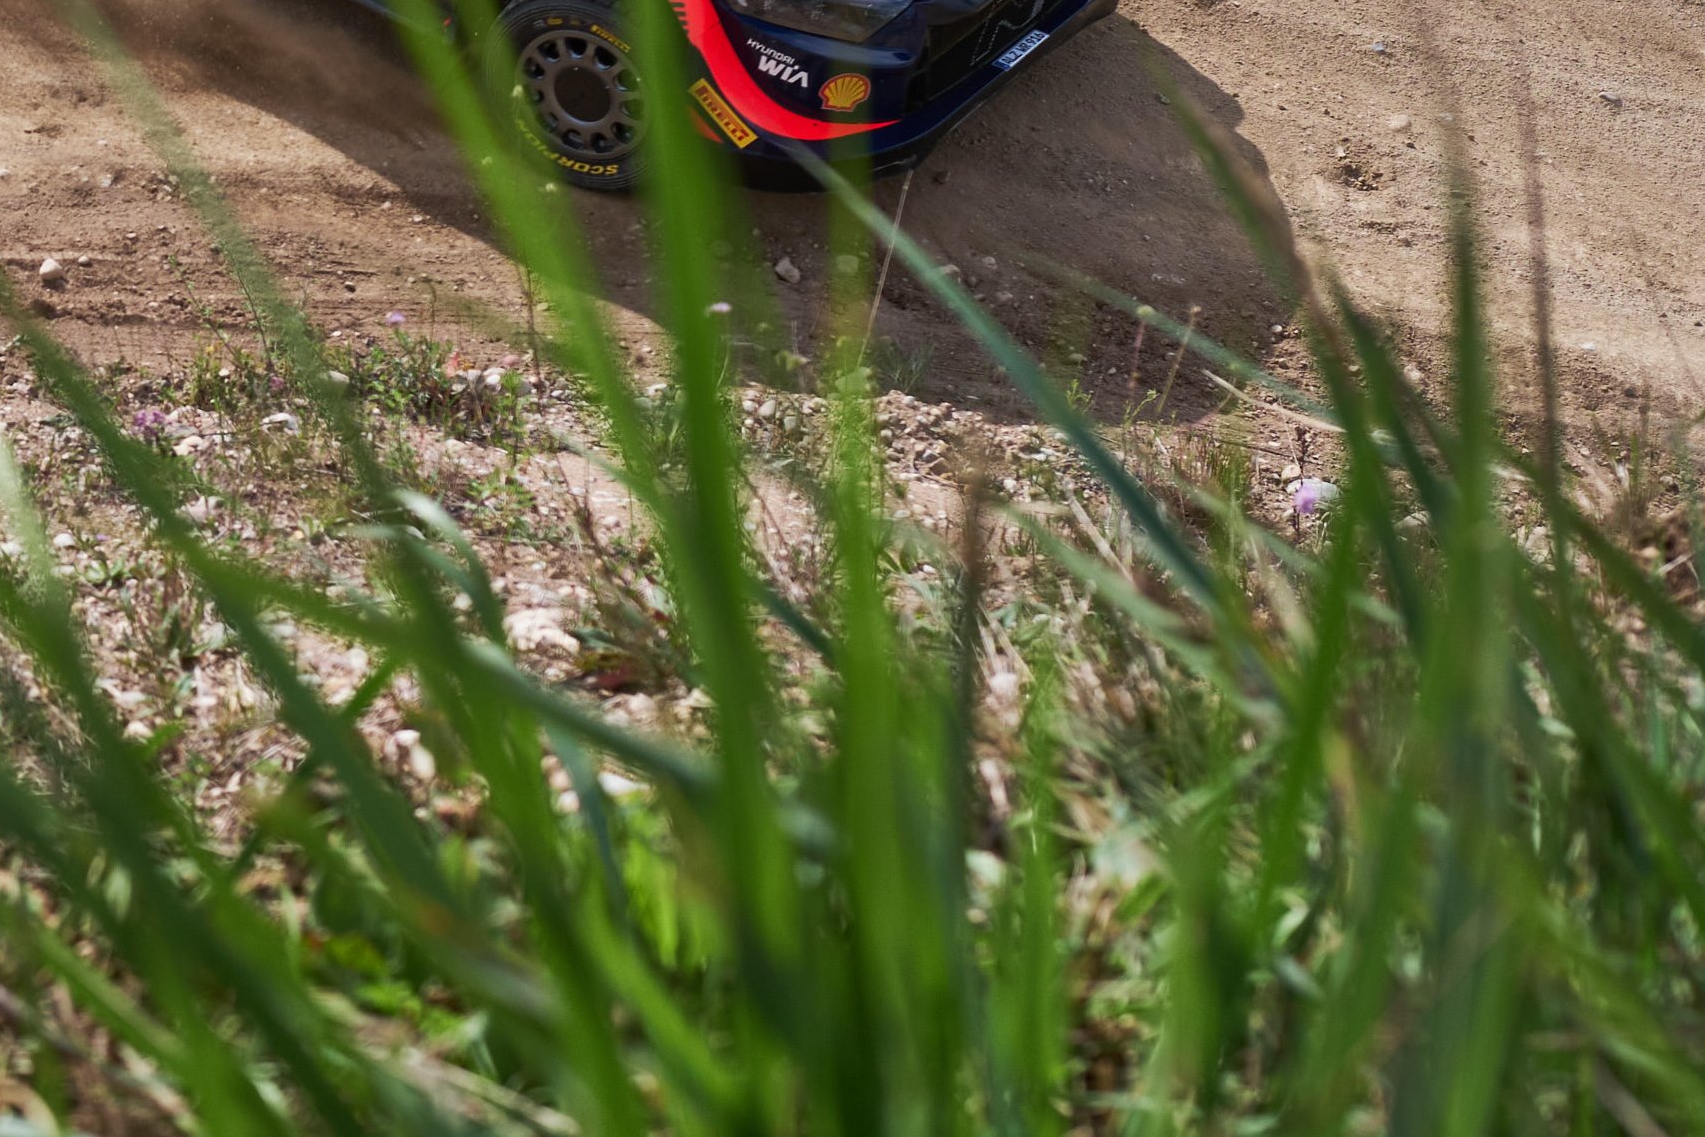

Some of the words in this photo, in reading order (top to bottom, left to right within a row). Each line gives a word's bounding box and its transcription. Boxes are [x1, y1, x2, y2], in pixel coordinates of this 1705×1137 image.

[746, 38, 796, 65] HYUNDAI
[1026, 31, 1047, 47] 916
[757, 54, 809, 88] WIA
